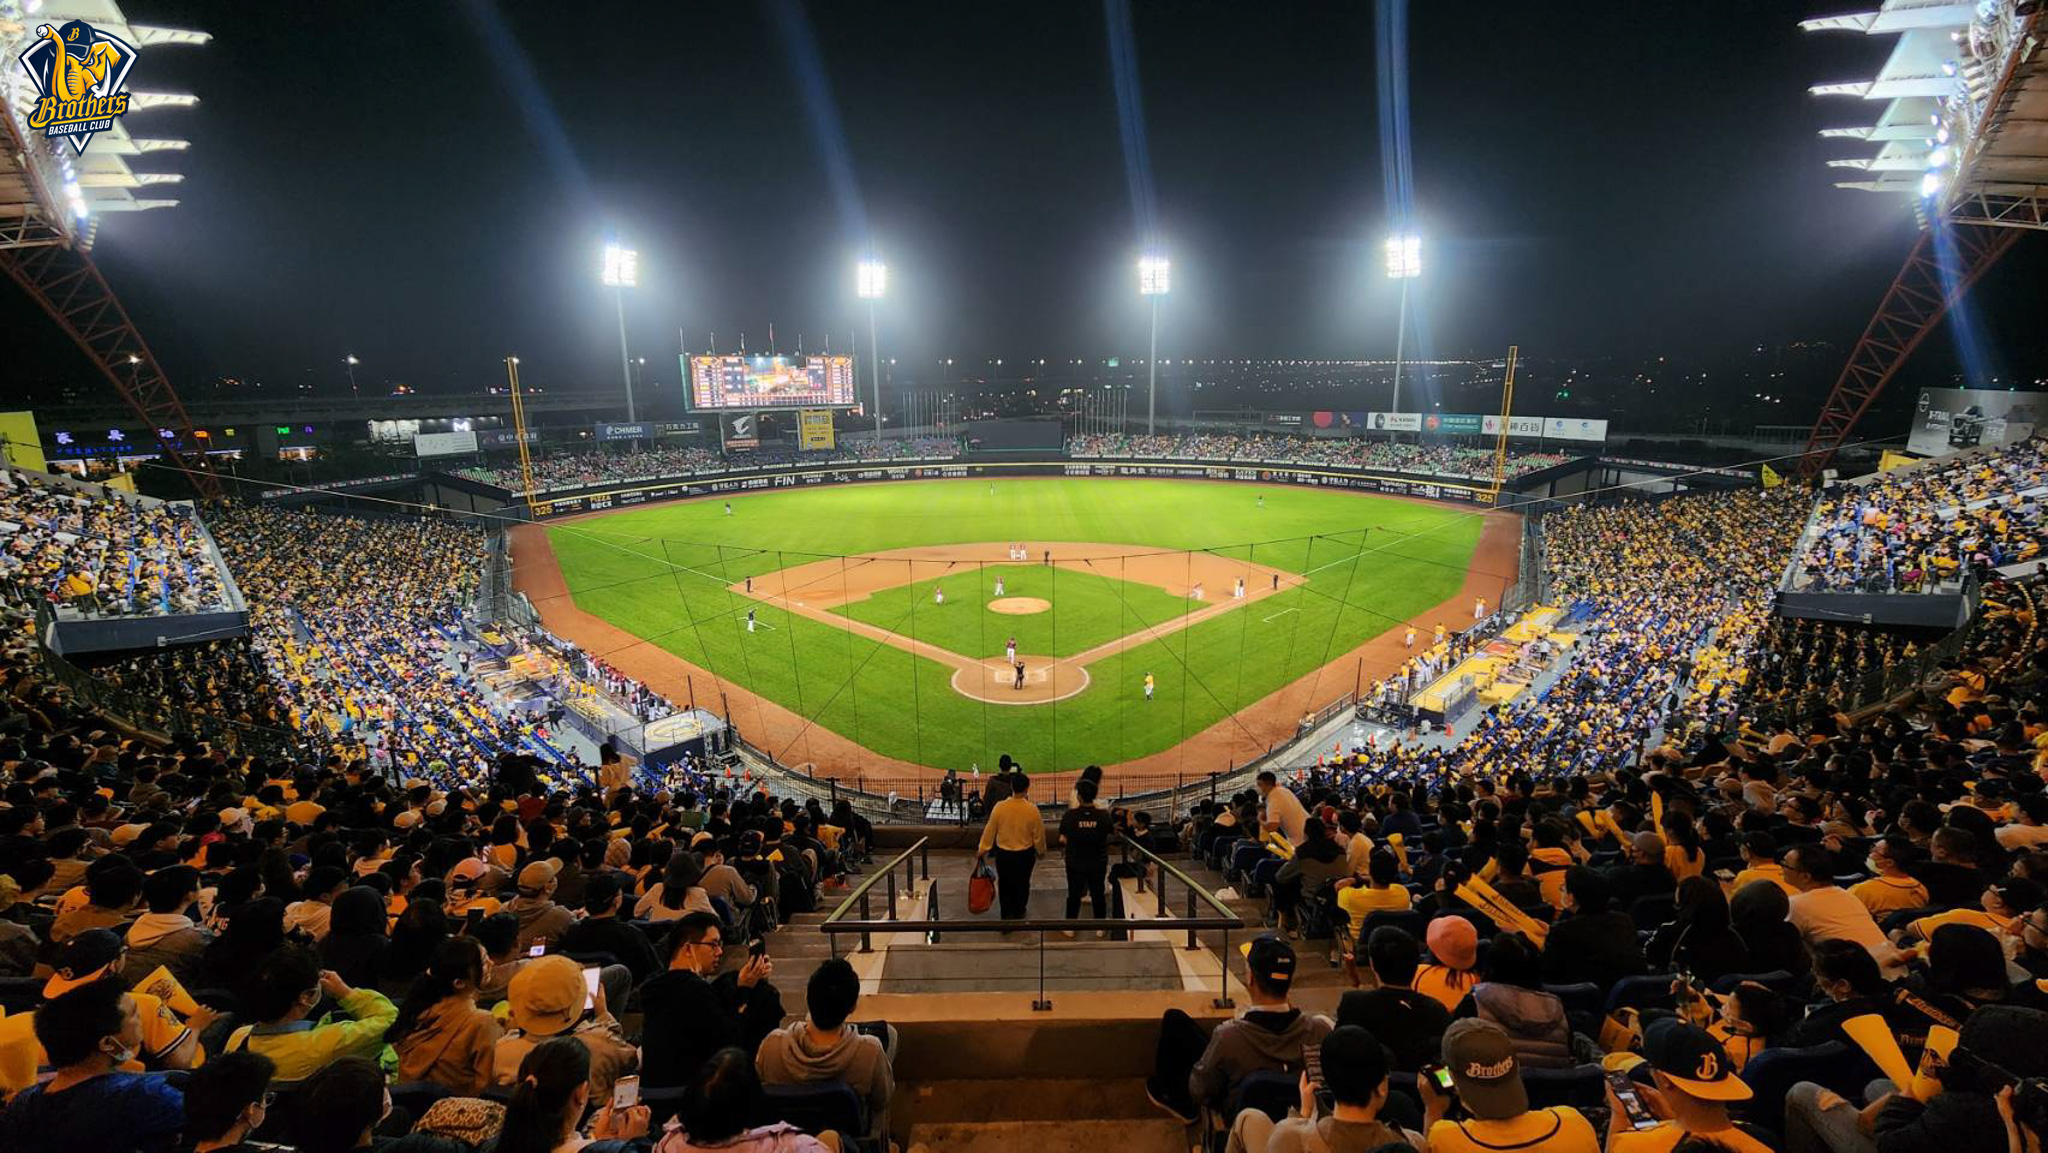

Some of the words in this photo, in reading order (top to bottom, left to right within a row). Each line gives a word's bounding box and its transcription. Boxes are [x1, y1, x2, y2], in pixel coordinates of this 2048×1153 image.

[774, 475, 796, 487] FIN
[1474, 493, 1494, 504] 325
[535, 505, 553, 516] 325
[1078, 820, 1097, 829] STAFF
[1465, 1056, 1514, 1080] Brothers
[1695, 1052, 1719, 1081] B
